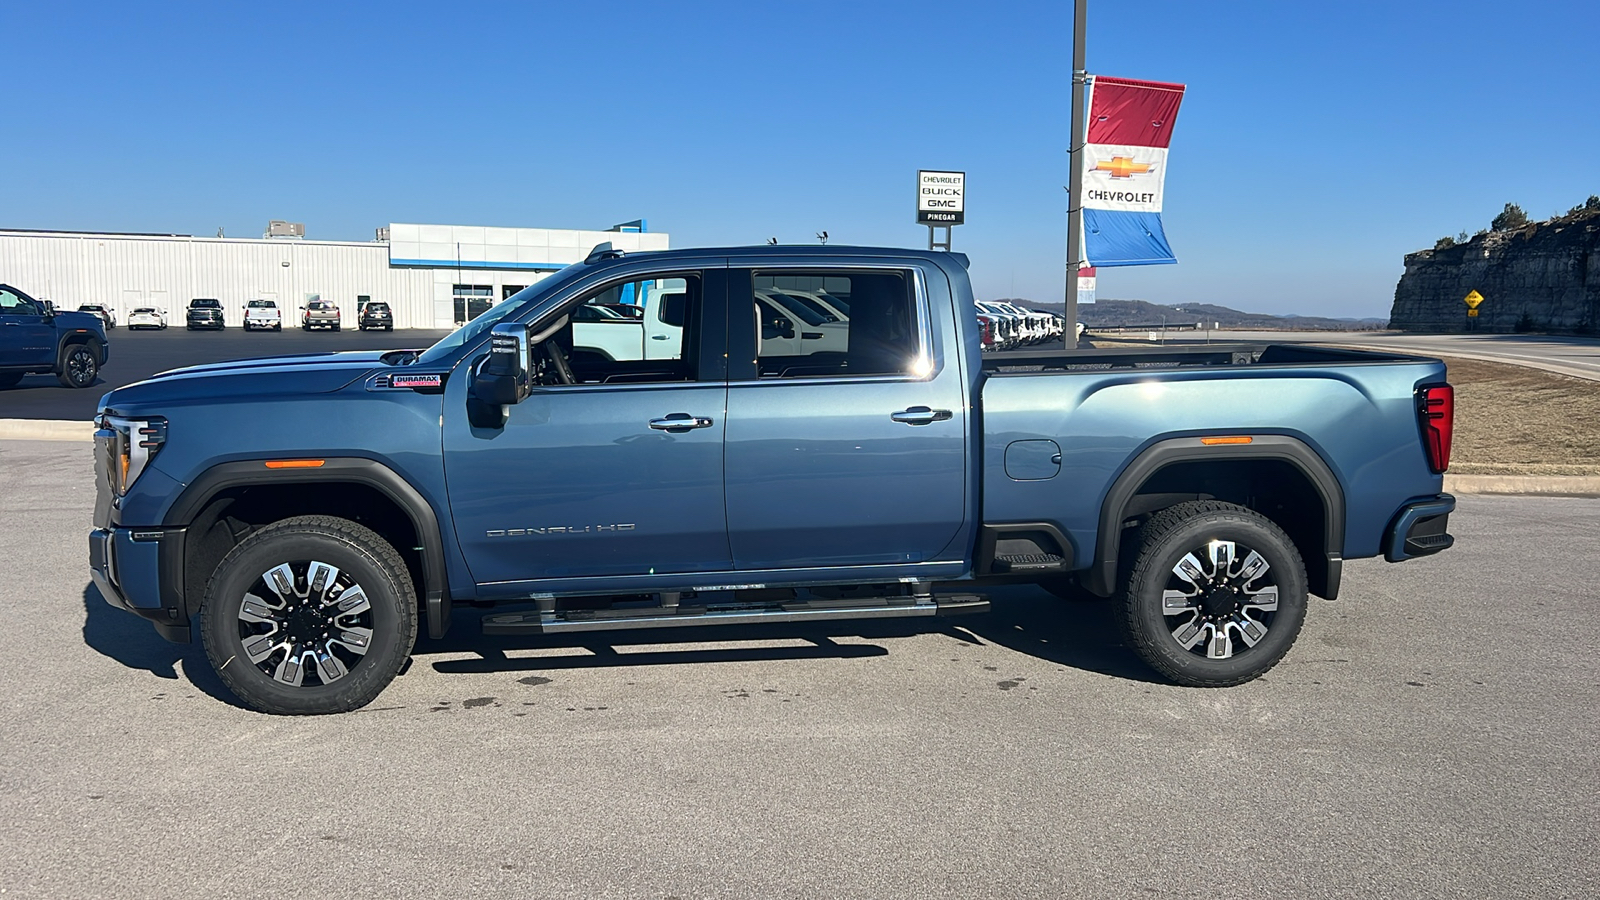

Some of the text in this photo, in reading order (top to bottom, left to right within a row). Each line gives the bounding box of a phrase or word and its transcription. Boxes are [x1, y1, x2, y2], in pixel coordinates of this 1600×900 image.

[923, 176, 961, 184] CHEVROLET
[922, 188, 961, 196] BUICK
[1088, 190, 1154, 203] CHEVROLET
[486, 524, 636, 537] DENALI HD
